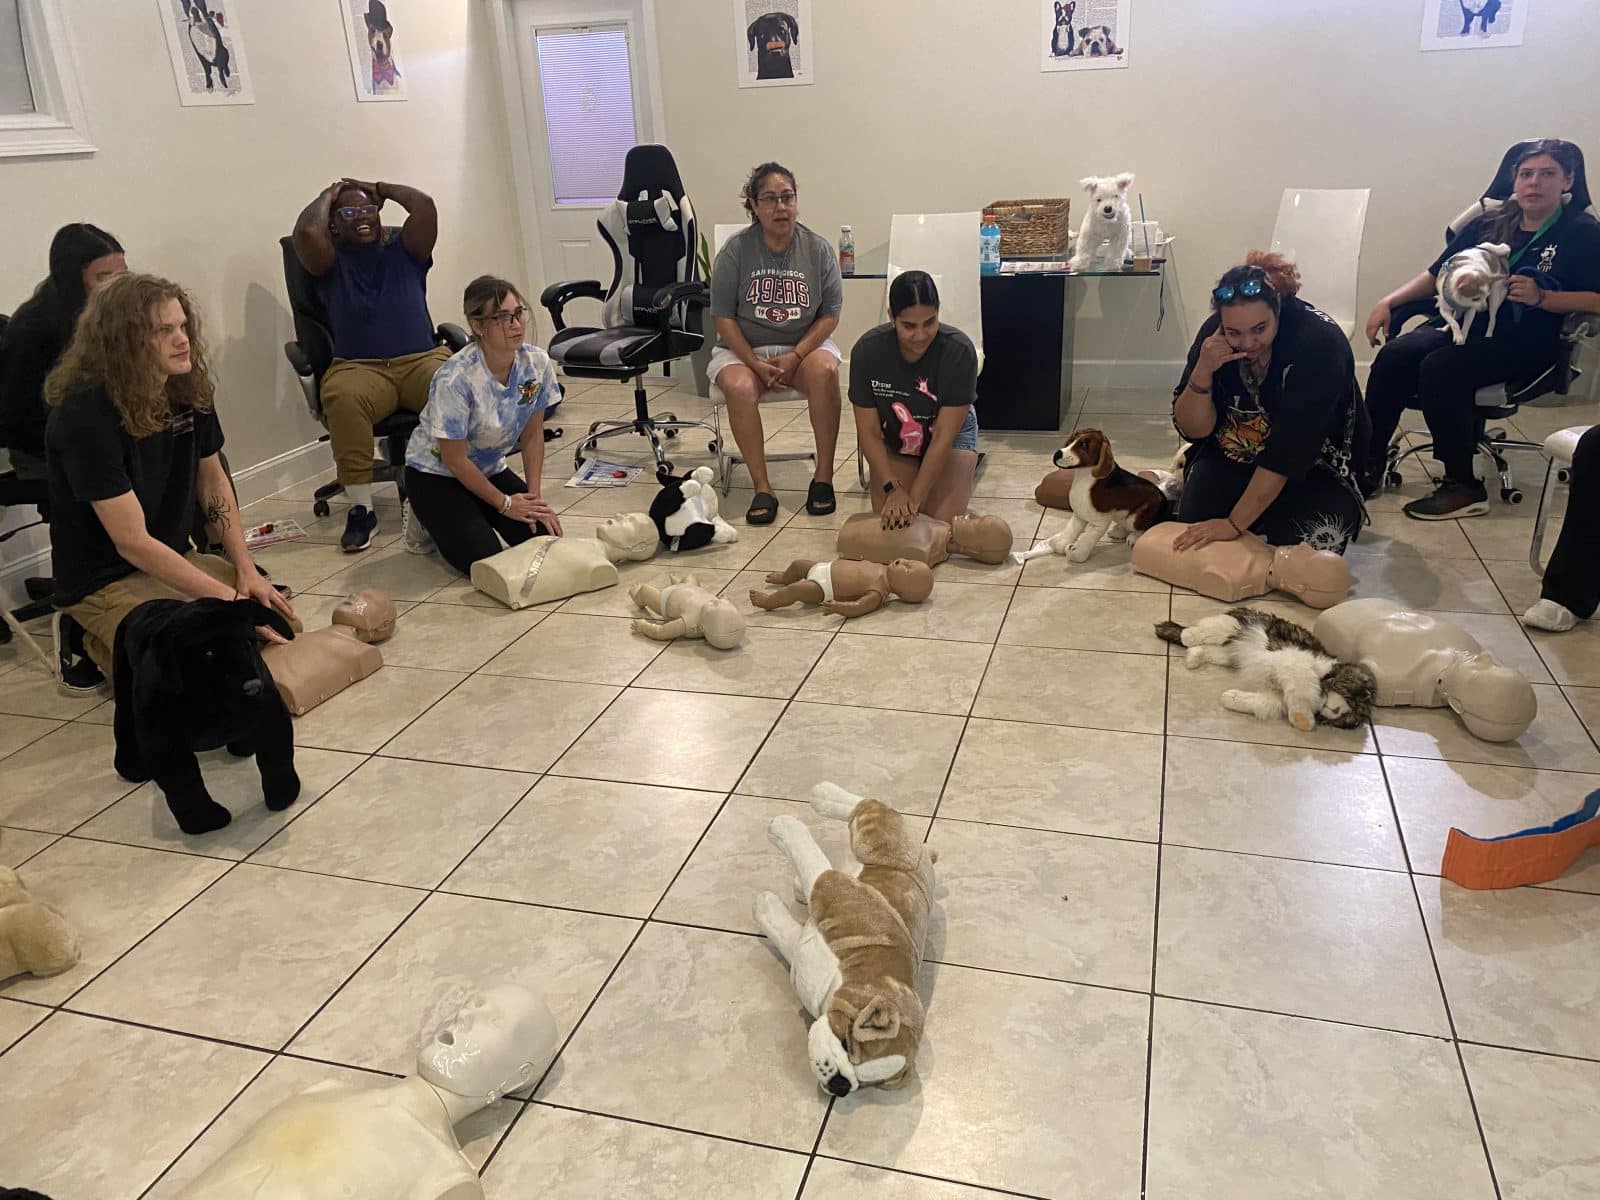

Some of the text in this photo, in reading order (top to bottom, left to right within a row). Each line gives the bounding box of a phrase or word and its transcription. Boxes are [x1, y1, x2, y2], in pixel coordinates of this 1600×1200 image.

[751, 269, 805, 279] SAN FRACISCO
[746, 277, 810, 308] 49ERS
